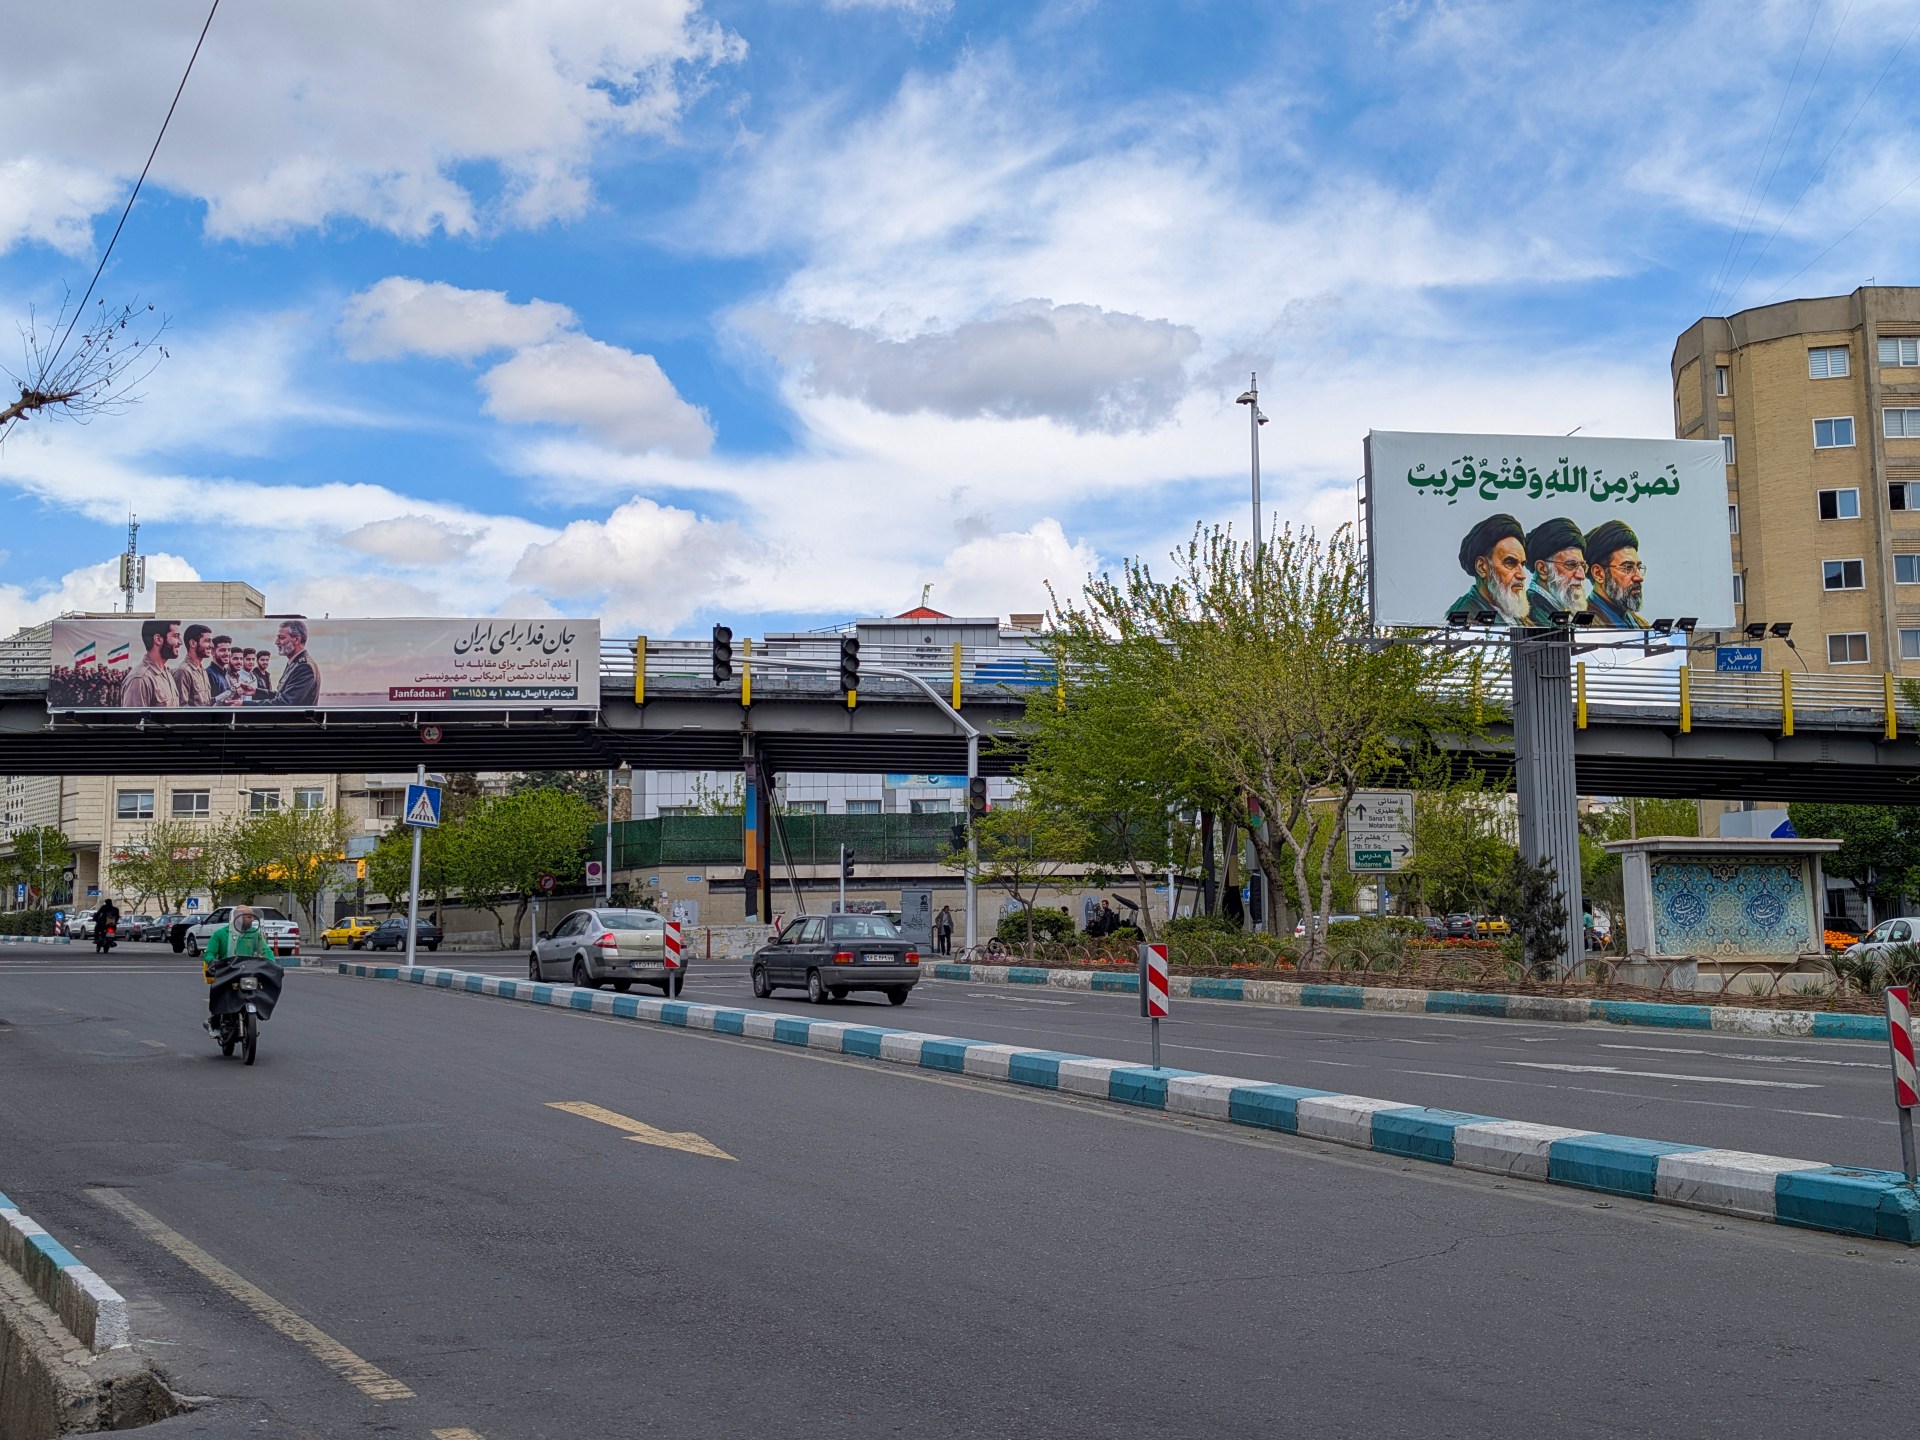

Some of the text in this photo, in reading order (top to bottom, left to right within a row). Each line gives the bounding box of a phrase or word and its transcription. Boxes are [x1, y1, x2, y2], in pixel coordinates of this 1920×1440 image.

[453, 622, 576, 655] جان فدا برای ایران
[454, 659, 572, 671] اعلام آمادگی برای مقابله با
[414, 671, 572, 683] تهدیدات دشمن آمریکایی صهیونیستی
[392, 688, 447, 698] Janfadaa.ir
[452, 688, 488, 698] ۳۰۰۰۱۱۵۵
[488, 689, 498, 699] به
[504, 689, 521, 697] عدد
[520, 689, 542, 699] ارسال
[548, 689, 560, 699] نام
[560, 688, 575, 698] ثبت
[1352, 833, 1381, 843] هفتم تیر
[1358, 852, 1382, 861] مدرس
